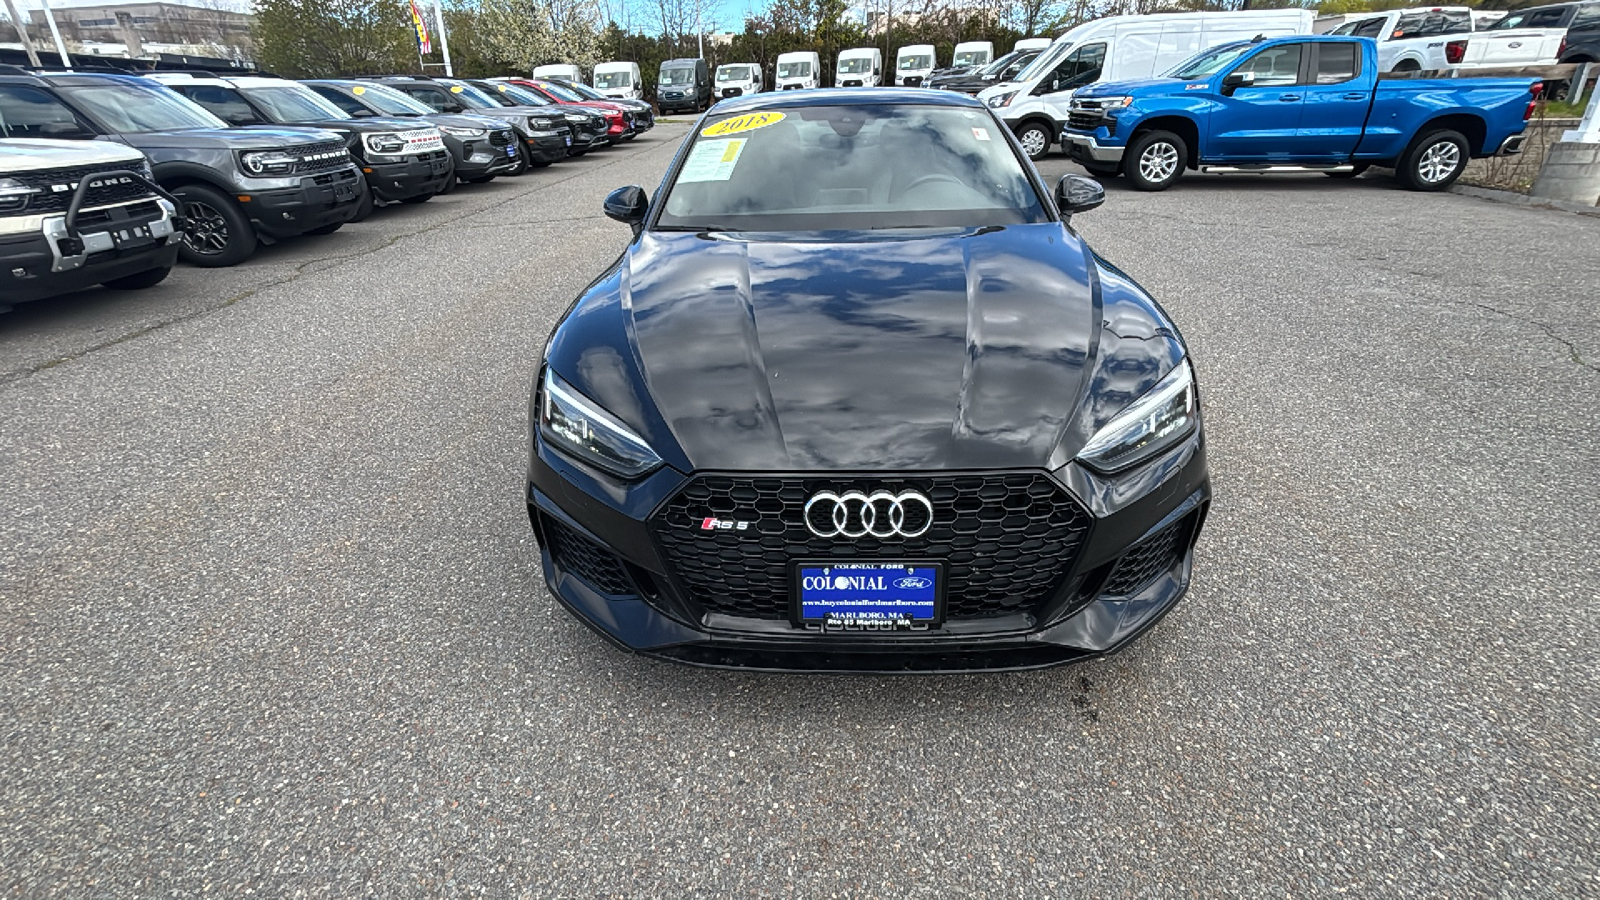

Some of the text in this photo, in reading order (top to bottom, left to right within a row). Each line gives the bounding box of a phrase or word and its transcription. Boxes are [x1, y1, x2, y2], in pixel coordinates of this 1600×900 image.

[716, 113, 771, 134] 2018
[303, 150, 347, 162] BRONCO
[708, 520, 749, 530] RS 5
[802, 576, 887, 590] COLONIAL
[900, 578, 924, 588] Ford
